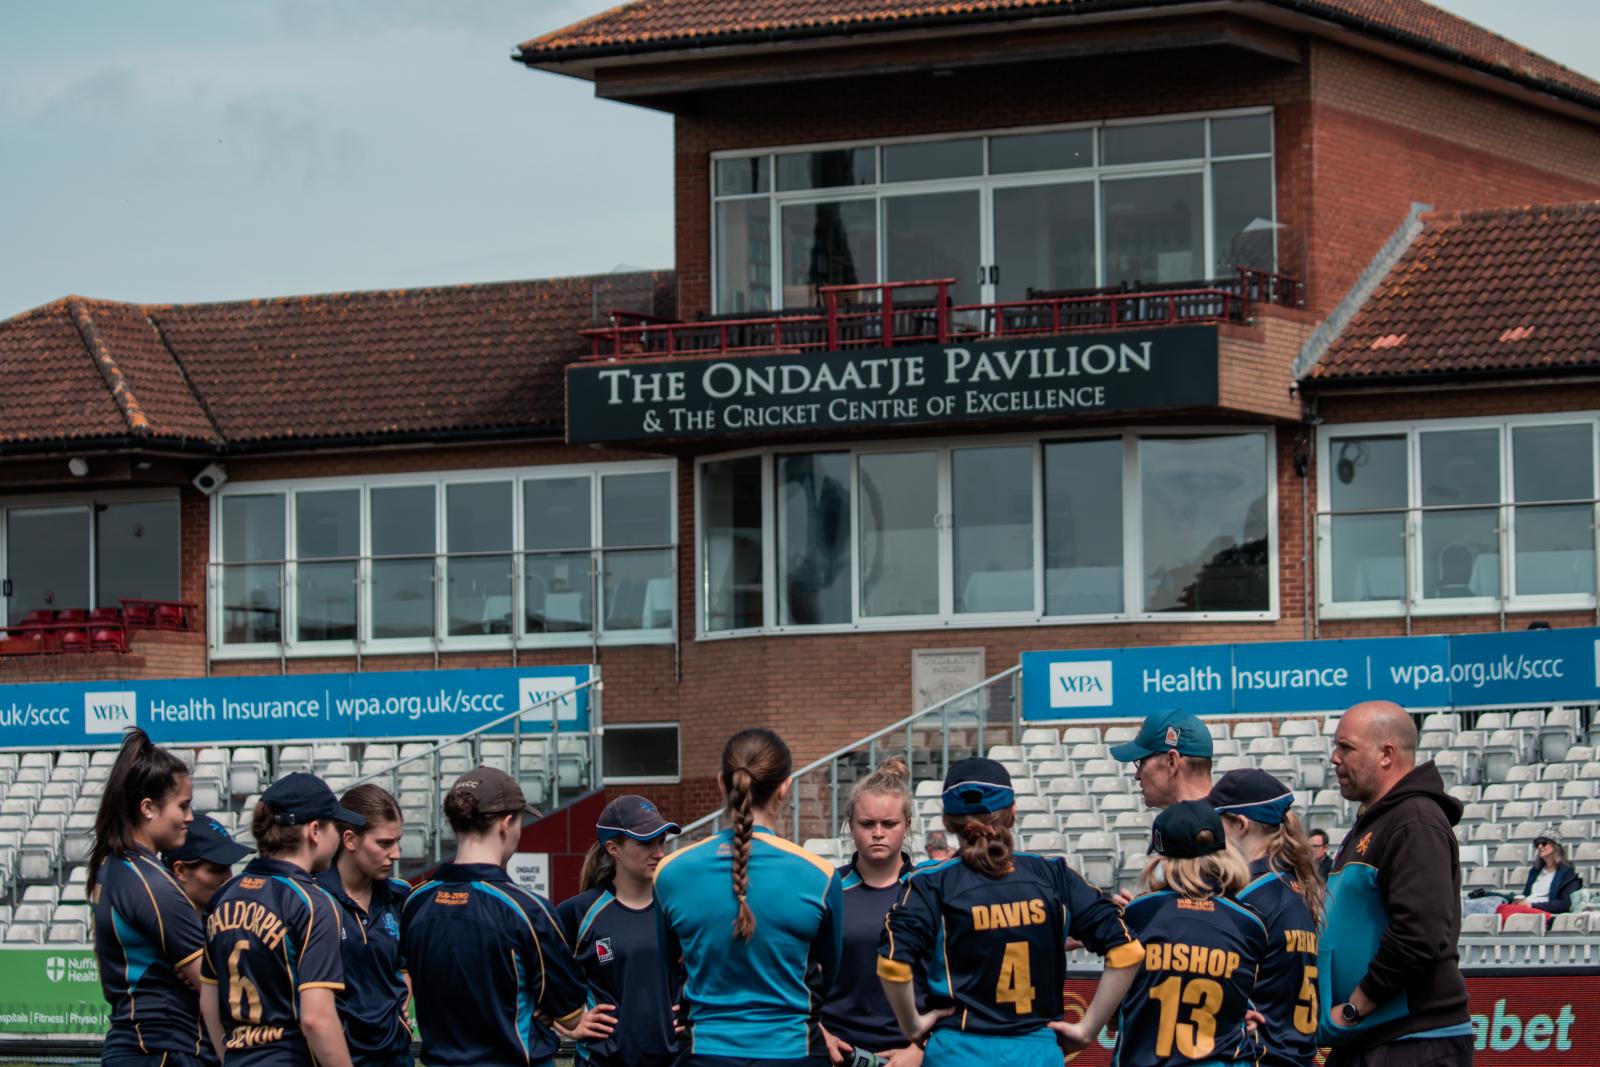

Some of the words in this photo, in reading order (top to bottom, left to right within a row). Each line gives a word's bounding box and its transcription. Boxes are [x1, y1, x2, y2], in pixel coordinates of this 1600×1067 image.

[599, 369, 686, 404] THE
[702, 356, 926, 399] ONDAATJE
[944, 341, 1153, 384] PAVILION
[642, 409, 664, 432] &
[669, 408, 715, 431] THE
[723, 403, 821, 428] CRICKET
[828, 398, 918, 423] CENTRE
[926, 396, 956, 416] OF
[966, 386, 1106, 414] EXCELLENCE
[1058, 674, 1104, 693] WPA
[1143, 665, 1222, 693] Health
[1232, 664, 1349, 690] Insurance
[1390, 653, 1565, 691] wpa.org.uk/sccc
[92, 704, 129, 721] WPA
[150, 697, 216, 722] Health
[223, 697, 320, 721] Insurance
[336, 689, 505, 721] wpa.org.uk/sccc
[971, 898, 1047, 931] DAVIS
[228, 939, 262, 1024] 6
[996, 941, 1035, 1014] 4
[1145, 943, 1240, 979] BISHOP
[0, 1012, 28, 1025] spitals
[34, 1012, 64, 1024] Fitness
[70, 1013, 98, 1026] Physio
[1149, 976, 1224, 1059] 13
[1293, 966, 1318, 1035] 5
[1470, 998, 1576, 1050] abet
